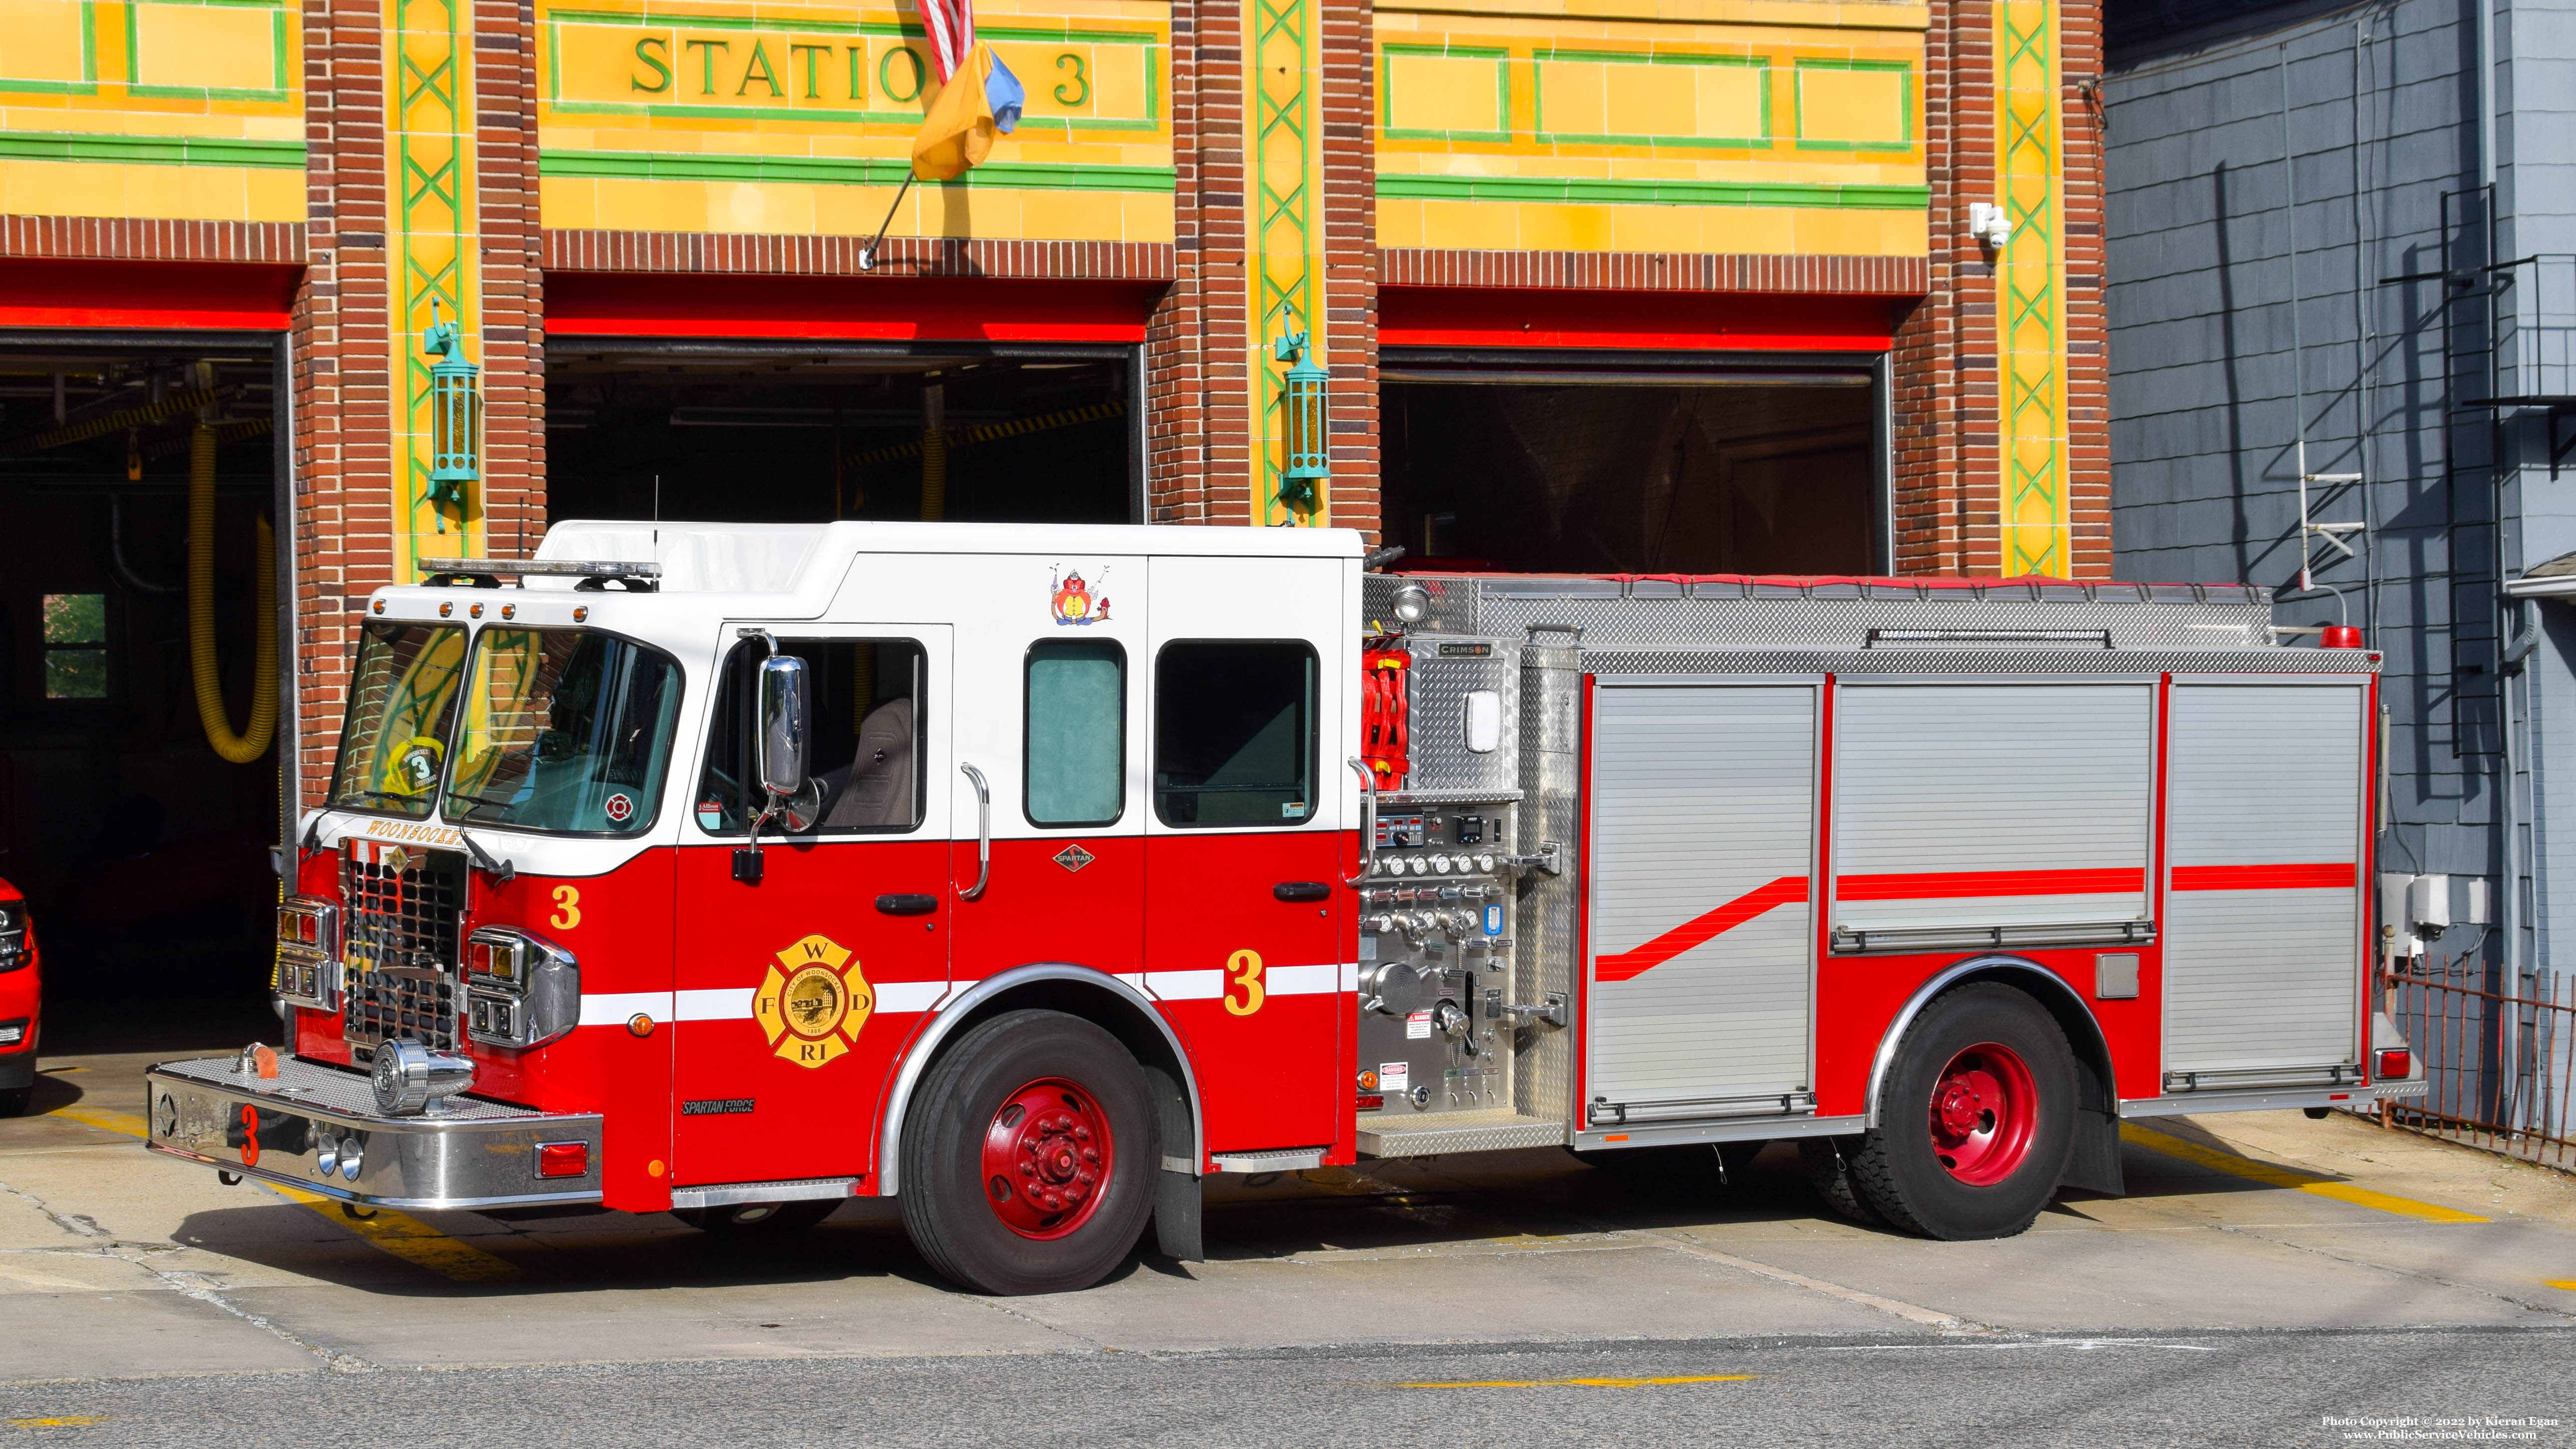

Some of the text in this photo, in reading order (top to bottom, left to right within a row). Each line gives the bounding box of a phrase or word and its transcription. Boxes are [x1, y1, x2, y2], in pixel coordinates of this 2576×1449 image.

[631, 37, 1089, 106] STATIO 3
[411, 755, 430, 779] 3
[550, 885, 581, 930] 3
[802, 943, 828, 959] W
[787, 981, 796, 996] CITY
[806, 969, 842, 993] WOONSOCKET
[1224, 948, 1265, 1017] 3
[760, 997, 776, 1013] F
[851, 994, 870, 1010] D
[799, 1043, 828, 1060] RI
[683, 1099, 755, 1114] SPARTAN FORCE
[241, 1103, 259, 1166] 3
